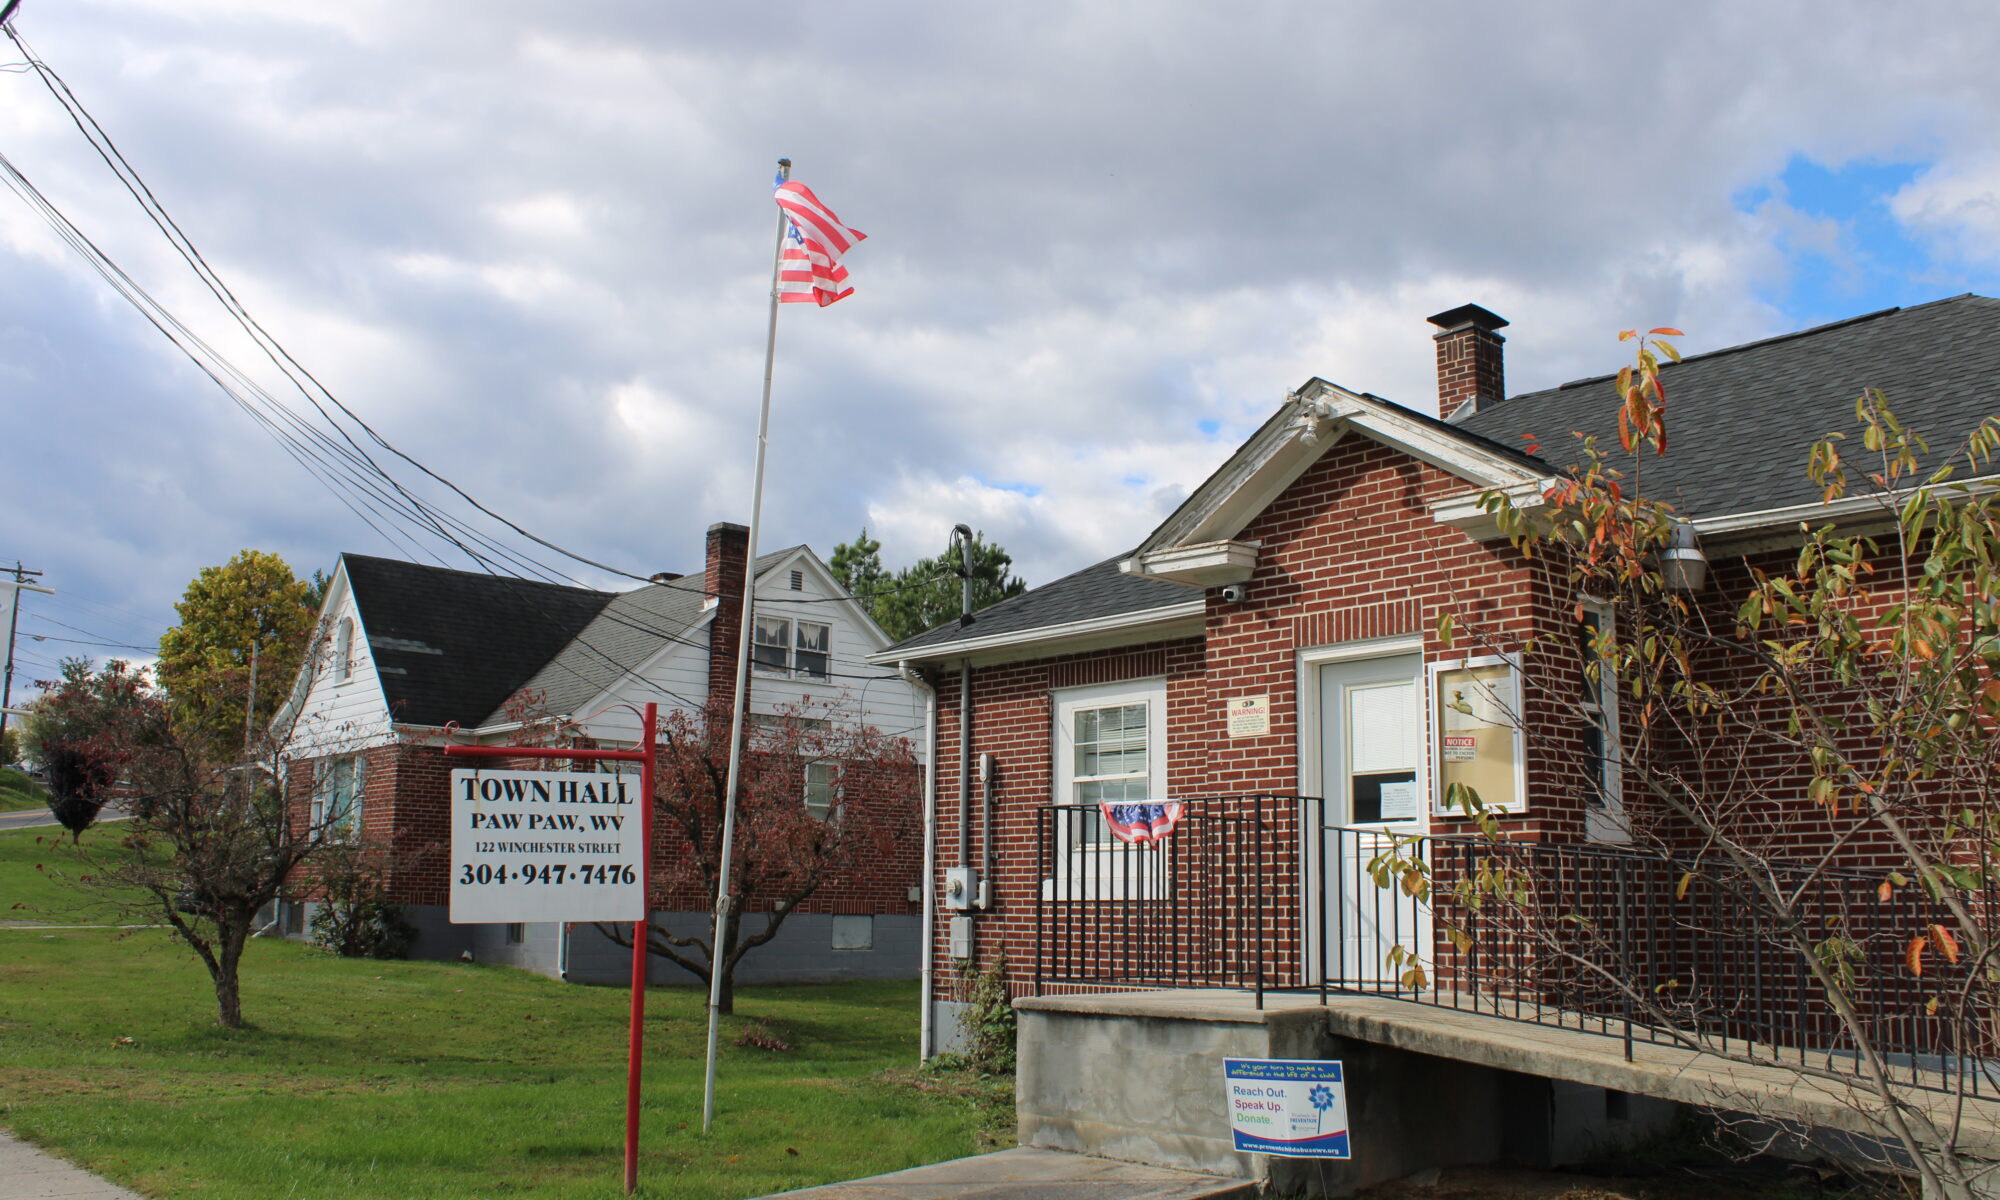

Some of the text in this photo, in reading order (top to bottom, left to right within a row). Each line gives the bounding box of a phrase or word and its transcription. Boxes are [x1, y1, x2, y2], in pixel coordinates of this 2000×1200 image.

[1446, 738, 1473, 746] NOTICE
[460, 777, 634, 805] TOWN HALL
[471, 813, 625, 833] PAW PAW, WV
[475, 841, 622, 854] 122 WINCHESTER STREET
[1233, 1085, 1287, 1098] Reach Out.
[1235, 1099, 1284, 1113] Speak Up.
[1236, 1113, 1273, 1125] Donate.
